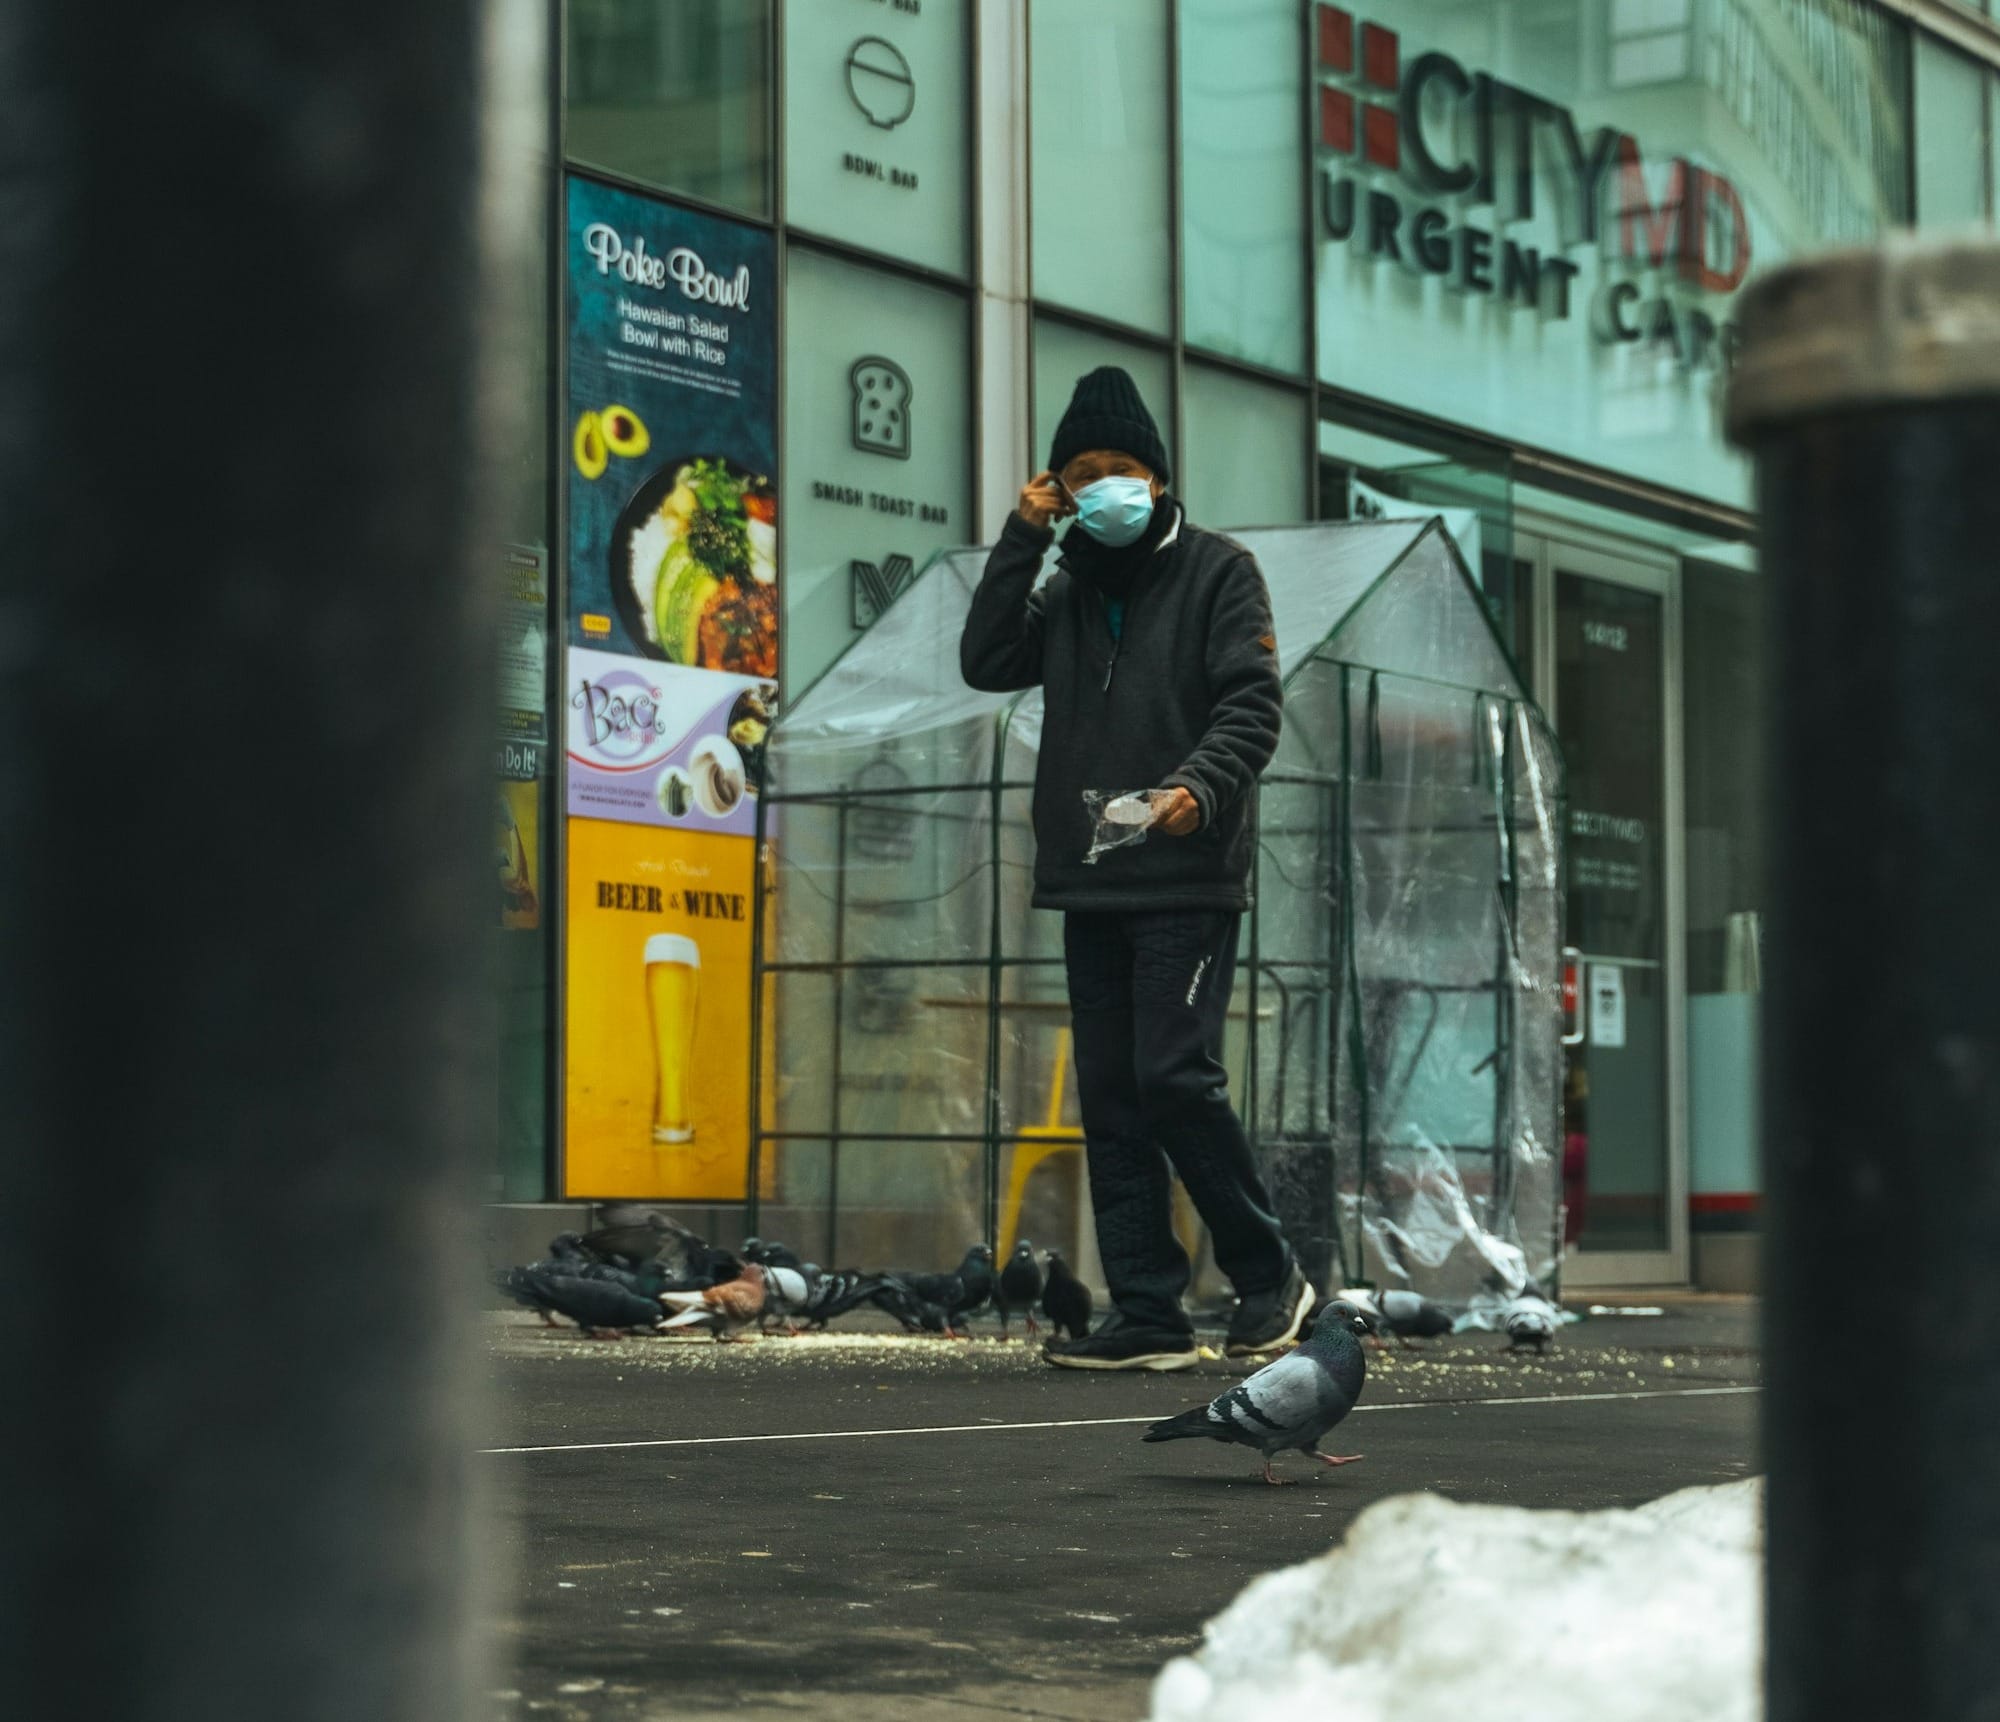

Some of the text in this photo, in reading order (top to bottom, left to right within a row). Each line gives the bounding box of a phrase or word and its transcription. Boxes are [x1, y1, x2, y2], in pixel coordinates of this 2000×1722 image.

[842, 153, 919, 190] BOWL BAR
[582, 222, 750, 312] Poke Bowl
[1320, 173, 1735, 370] URGENT CAR
[618, 298, 729, 342] Hawaiian Salad
[622, 321, 726, 365] Bowl with Rice
[812, 481, 948, 525] SMASH TOAST BAR
[572, 679, 666, 747] Baci
[596, 881, 745, 922] BEER & WINE
